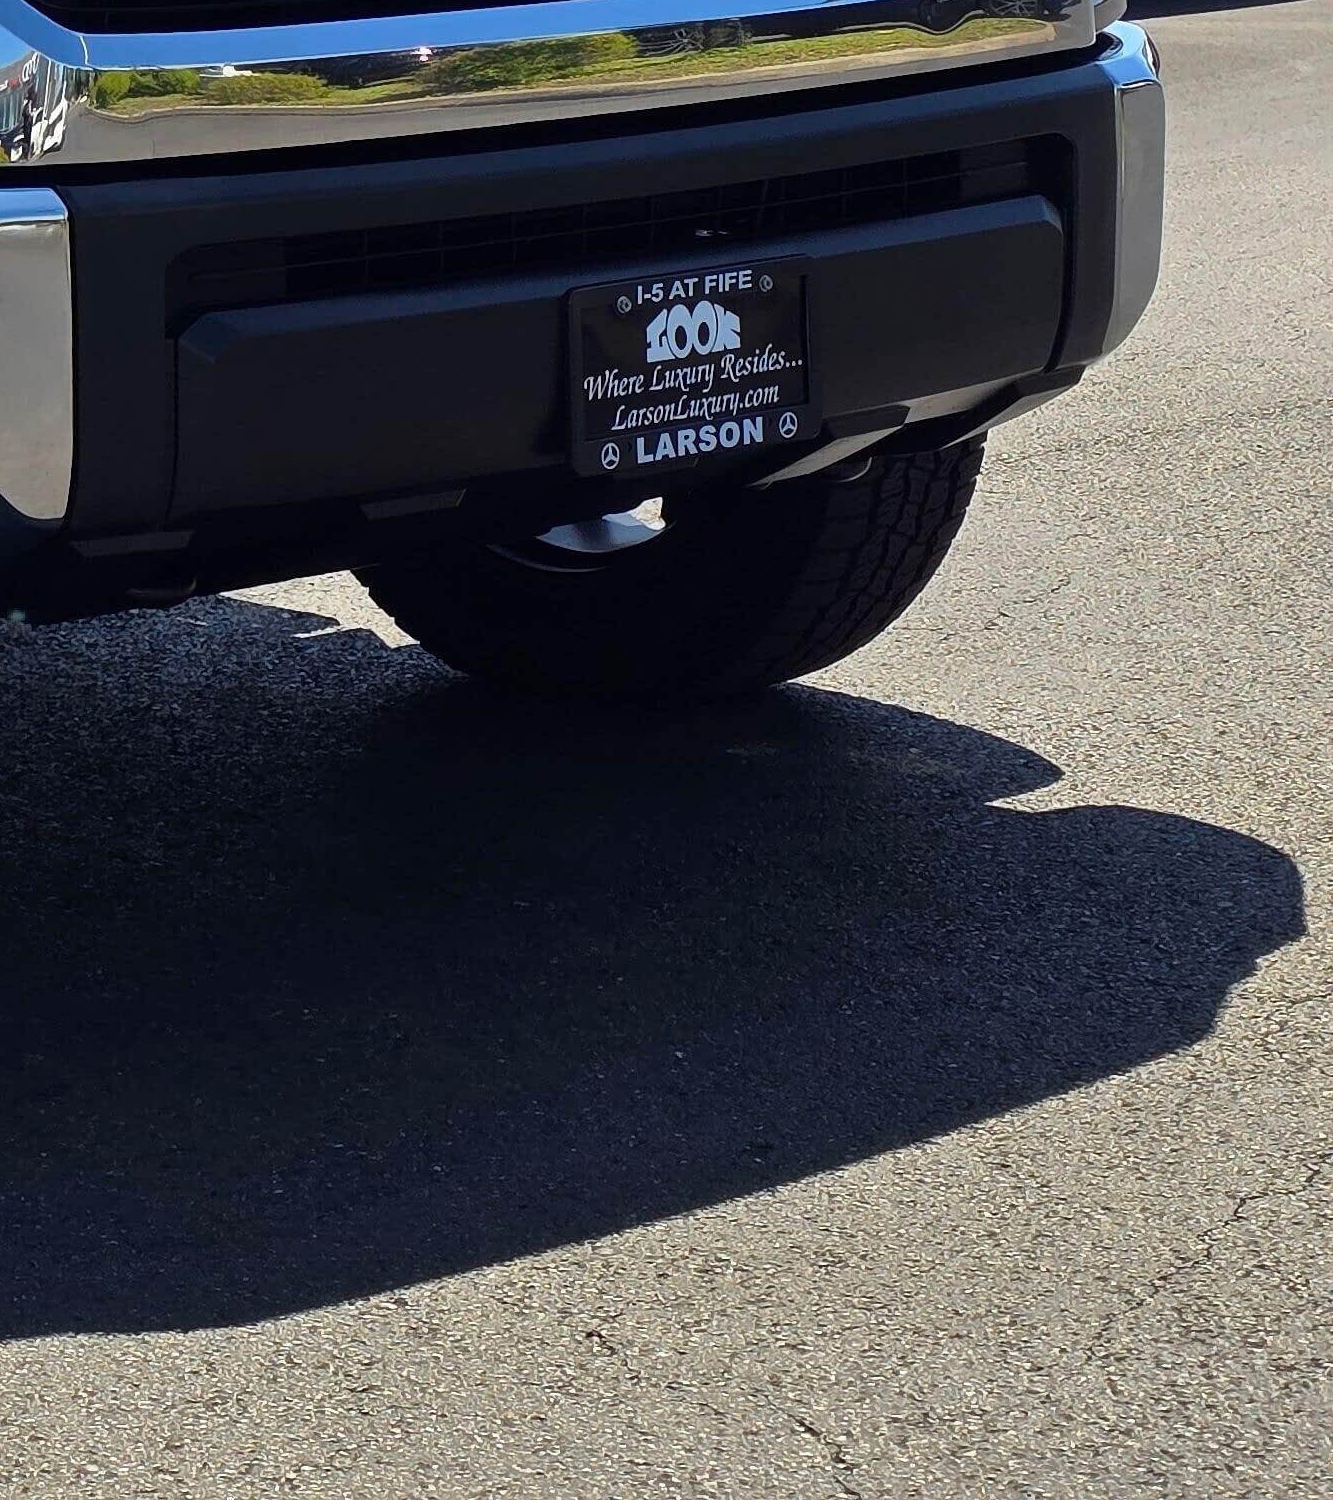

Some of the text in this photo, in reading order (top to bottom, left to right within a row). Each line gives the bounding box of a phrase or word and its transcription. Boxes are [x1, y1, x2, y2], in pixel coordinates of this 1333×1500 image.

[637, 269, 752, 305] I-5 AT FIFE
[583, 343, 803, 401] Where Luxury Resides...
[611, 384, 780, 431] LarsonLuxury.com
[636, 416, 764, 465] LARSON
